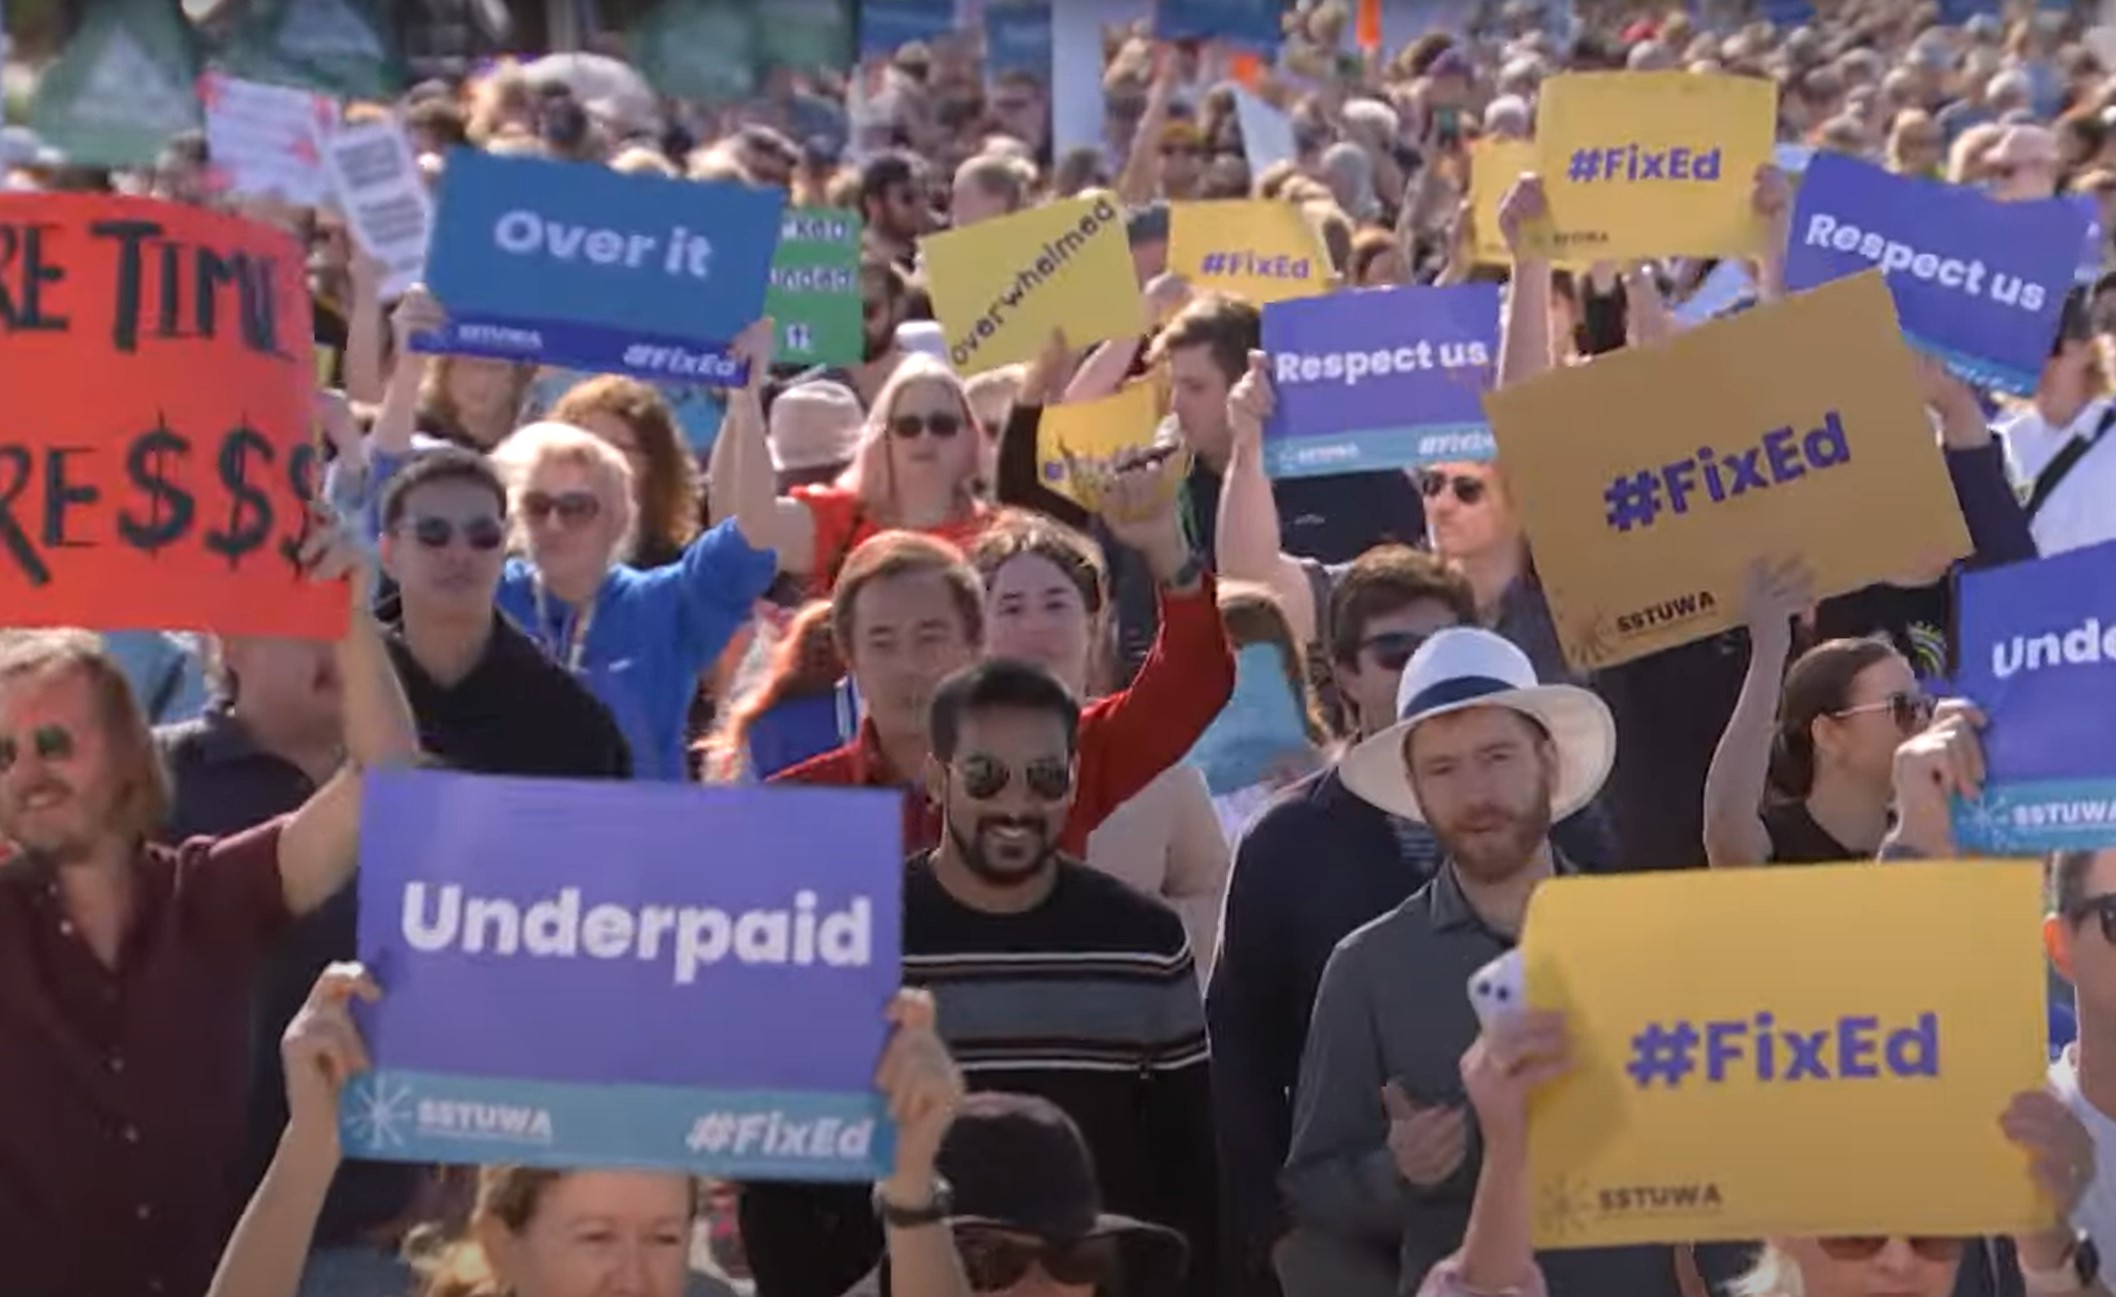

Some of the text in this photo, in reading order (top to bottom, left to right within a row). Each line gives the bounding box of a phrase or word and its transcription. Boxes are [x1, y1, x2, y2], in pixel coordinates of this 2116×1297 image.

[1566, 142, 1722, 182] #FixEd
[494, 209, 713, 278] Over it
[1202, 249, 1311, 280] #FixEd
[1806, 213, 2046, 312] Respect us
[951, 197, 1115, 366] overwhelmed
[622, 343, 738, 378] #FixEd
[1276, 340, 1489, 386] Respect us
[1603, 408, 1851, 533] #FixEd
[1616, 590, 1715, 633] SSTUWA
[401, 881, 872, 985] Underpaid
[1626, 1011, 1940, 1089] #FixEd
[418, 1098, 875, 1158] SSTUWA #FixEd
[1599, 1182, 1723, 1212] SSTUWA
